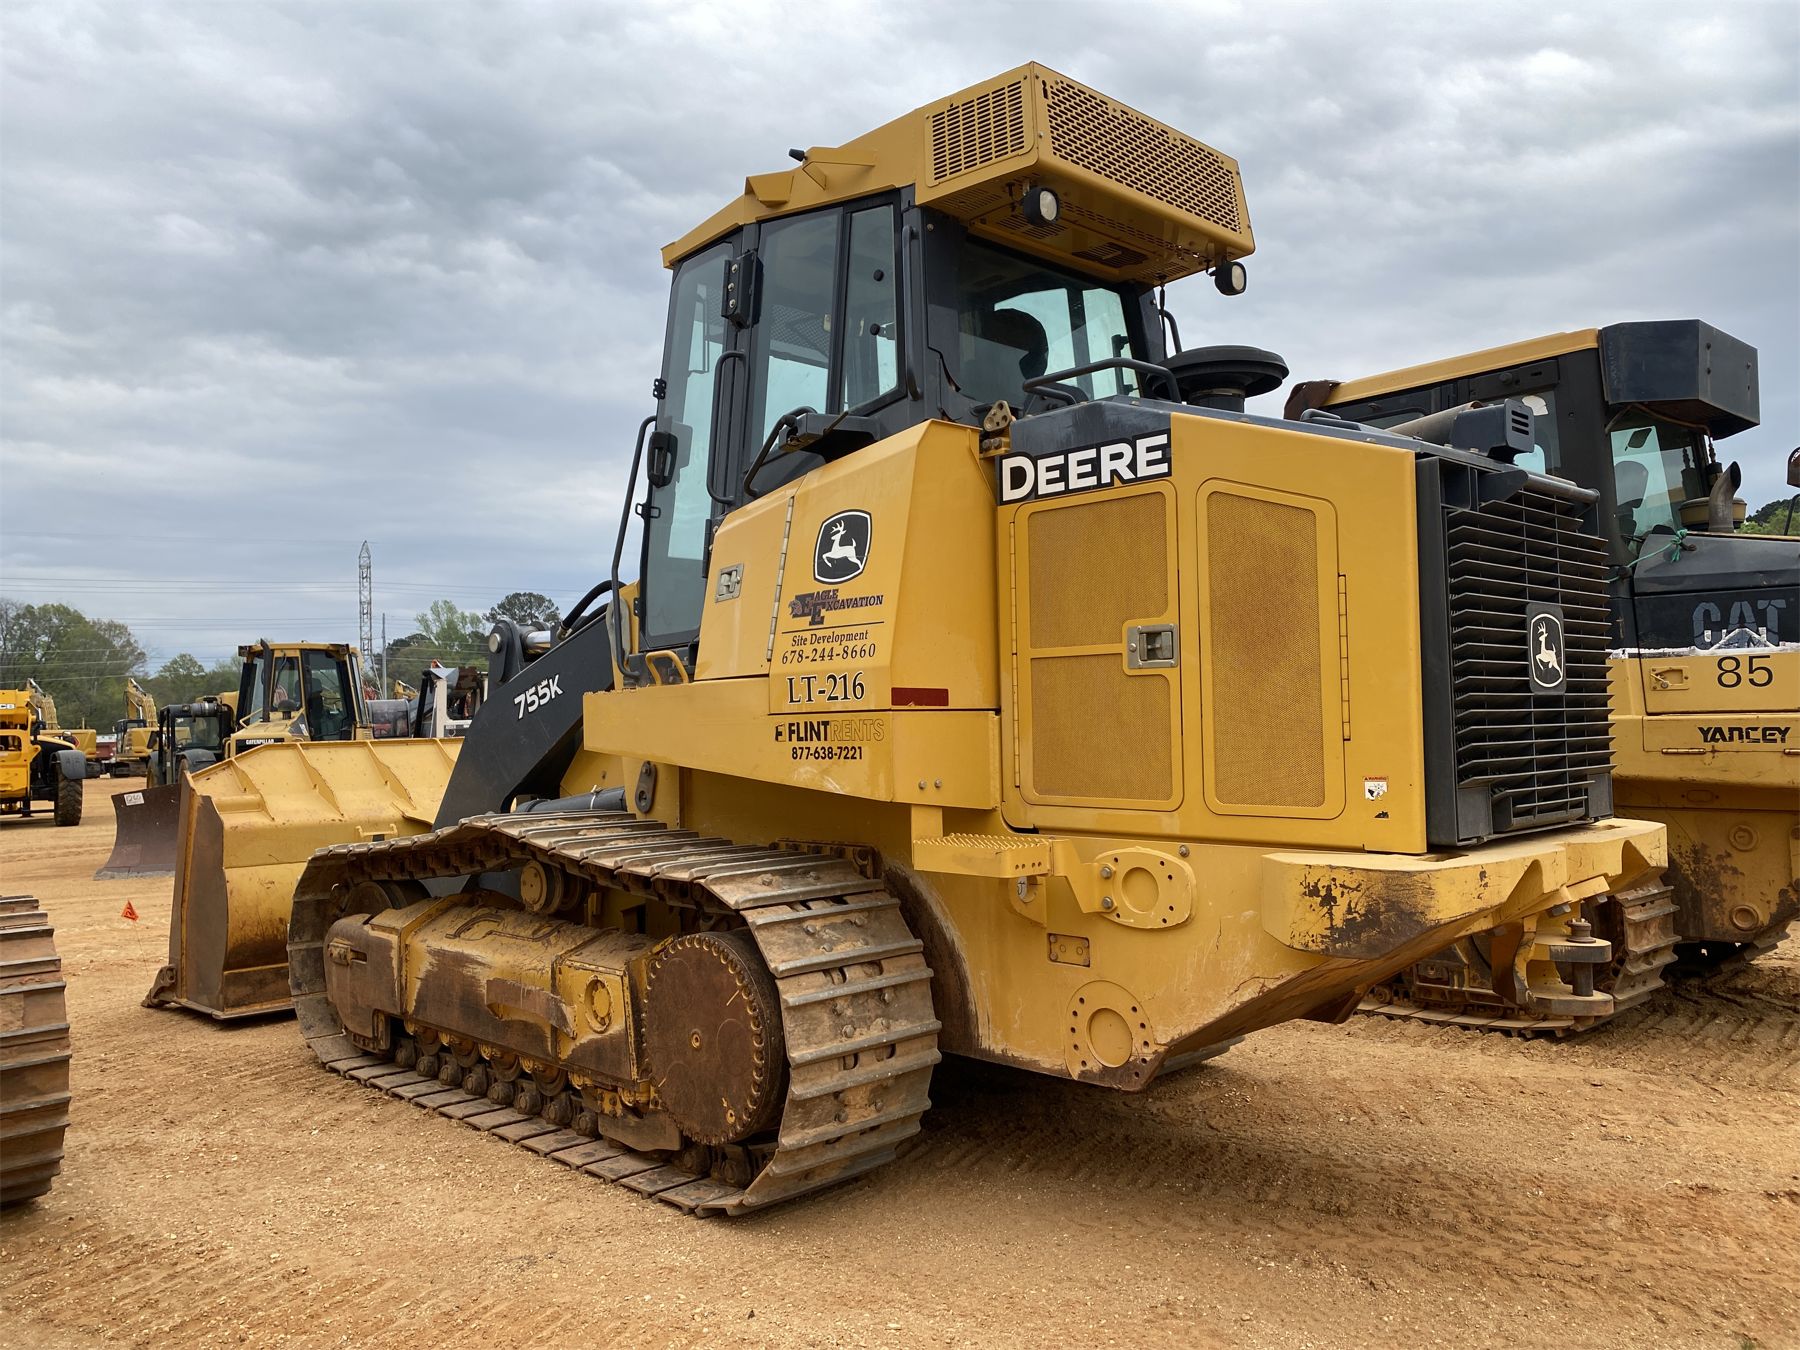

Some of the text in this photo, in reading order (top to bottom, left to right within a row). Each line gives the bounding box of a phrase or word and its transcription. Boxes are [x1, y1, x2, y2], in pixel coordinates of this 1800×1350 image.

[1002, 434, 1168, 501] DEERE
[791, 630, 868, 647] Site Development
[1692, 599, 1787, 650] CAT
[782, 643, 876, 664] 678-244-8660
[1717, 655, 1773, 688] 85
[514, 674, 563, 720] 755K
[787, 672, 865, 703] LT-216
[1697, 726, 1791, 743] YANCEY
[791, 746, 863, 760] 877-638-7221
